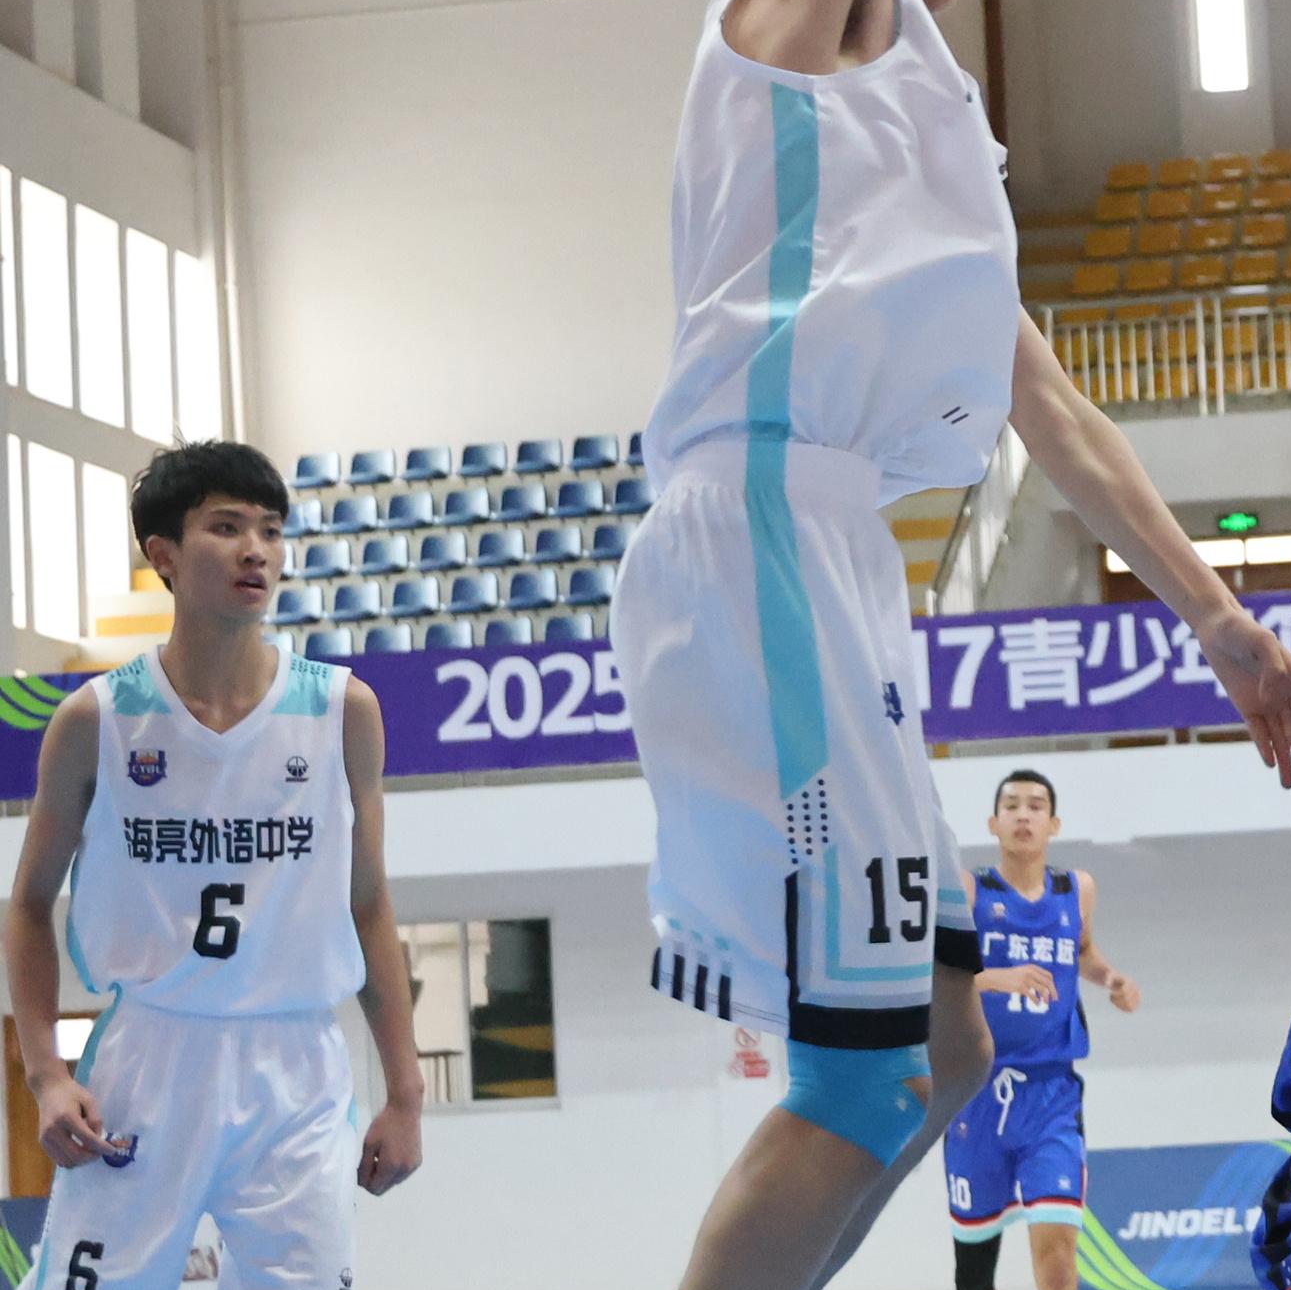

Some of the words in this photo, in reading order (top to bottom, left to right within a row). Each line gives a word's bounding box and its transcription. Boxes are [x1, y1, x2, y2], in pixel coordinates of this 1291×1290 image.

[436, 651, 634, 743] 2025
[123, 816, 314, 864] 海亮外语中学
[192, 882, 246, 959] 6
[864, 855, 931, 944] 15
[948, 1173, 973, 1211] 10
